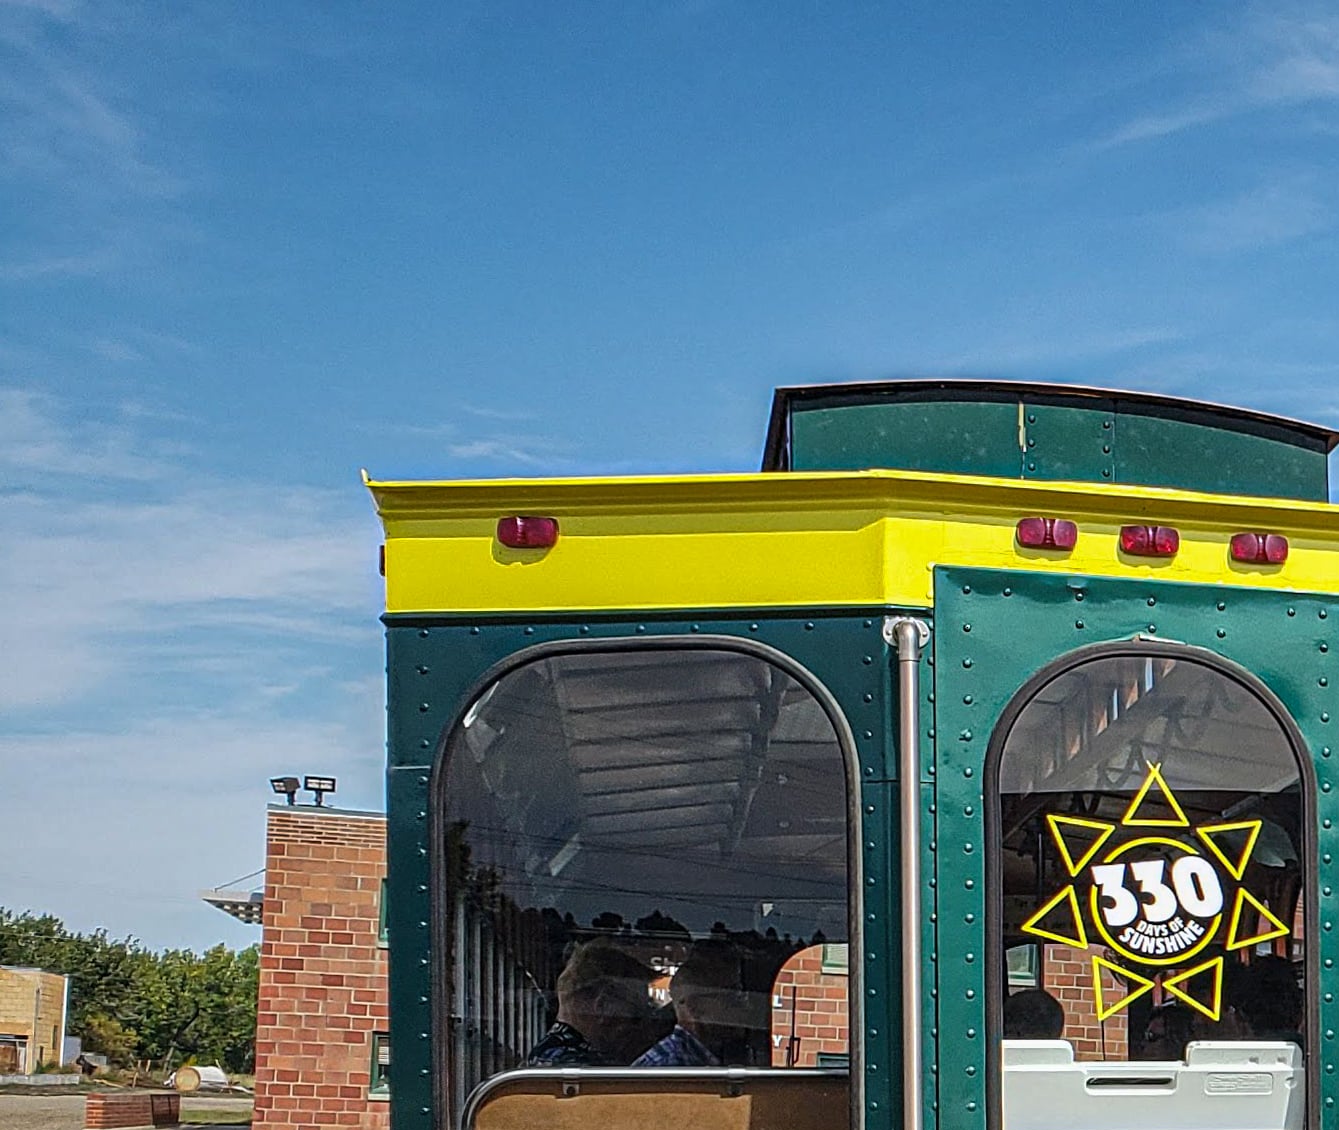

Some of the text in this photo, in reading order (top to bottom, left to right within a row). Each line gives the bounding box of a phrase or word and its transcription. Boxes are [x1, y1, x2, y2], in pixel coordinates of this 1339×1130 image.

[1091, 855, 1223, 927] 330
[1118, 919, 1206, 955] SUNSHINE
[1136, 916, 1185, 938] DAYS OF
